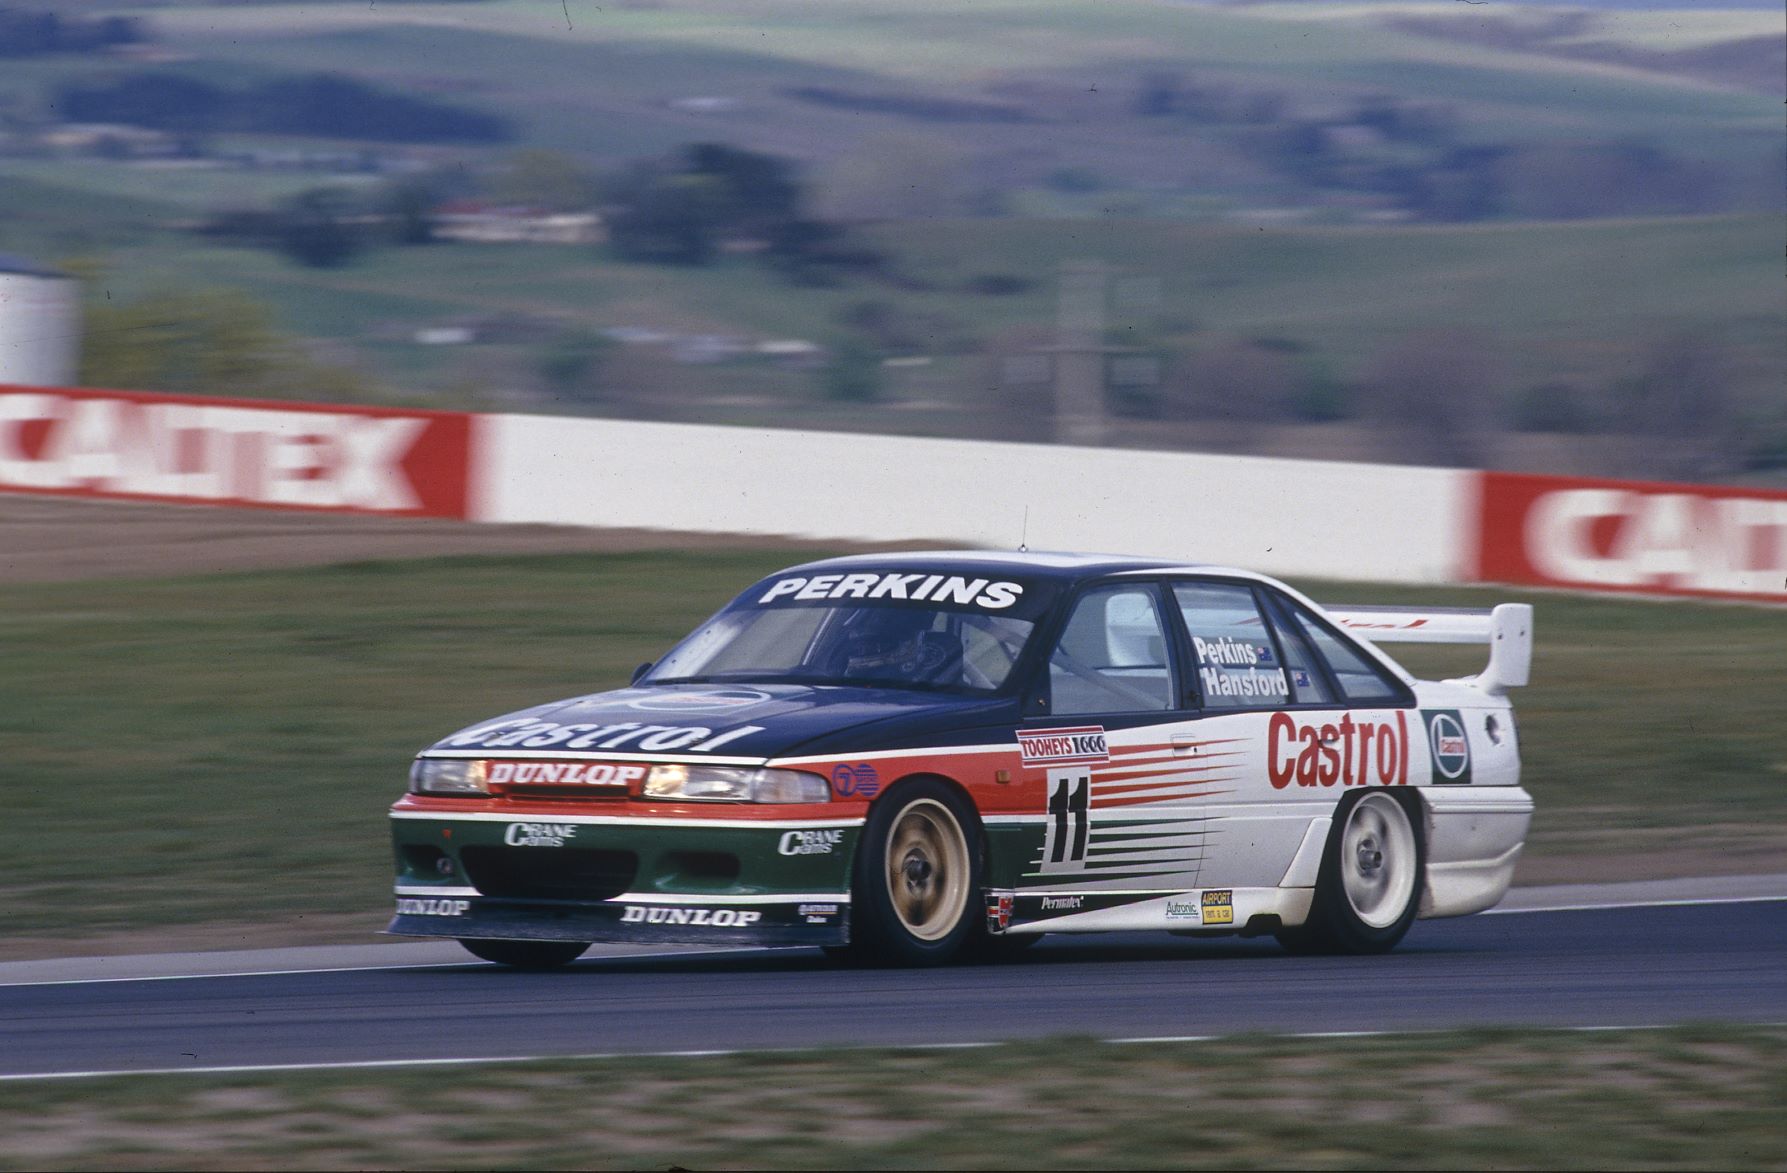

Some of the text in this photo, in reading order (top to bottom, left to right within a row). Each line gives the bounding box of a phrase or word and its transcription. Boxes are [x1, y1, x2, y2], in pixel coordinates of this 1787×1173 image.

[758, 573, 1023, 609] PERKINS
[1193, 636, 1257, 664] Perkins
[1200, 666, 1289, 696] Hansford
[448, 717, 767, 752] Castrol
[1020, 735, 1106, 757] TOOHEYS 1000
[1268, 711, 1409, 790] Castrol
[489, 763, 646, 785] DUNLOP
[1048, 777, 1088, 863] 11
[1165, 901, 1198, 916] Autronic
[1202, 891, 1231, 905] AIRPORT
[620, 906, 762, 927] DUNLOP
